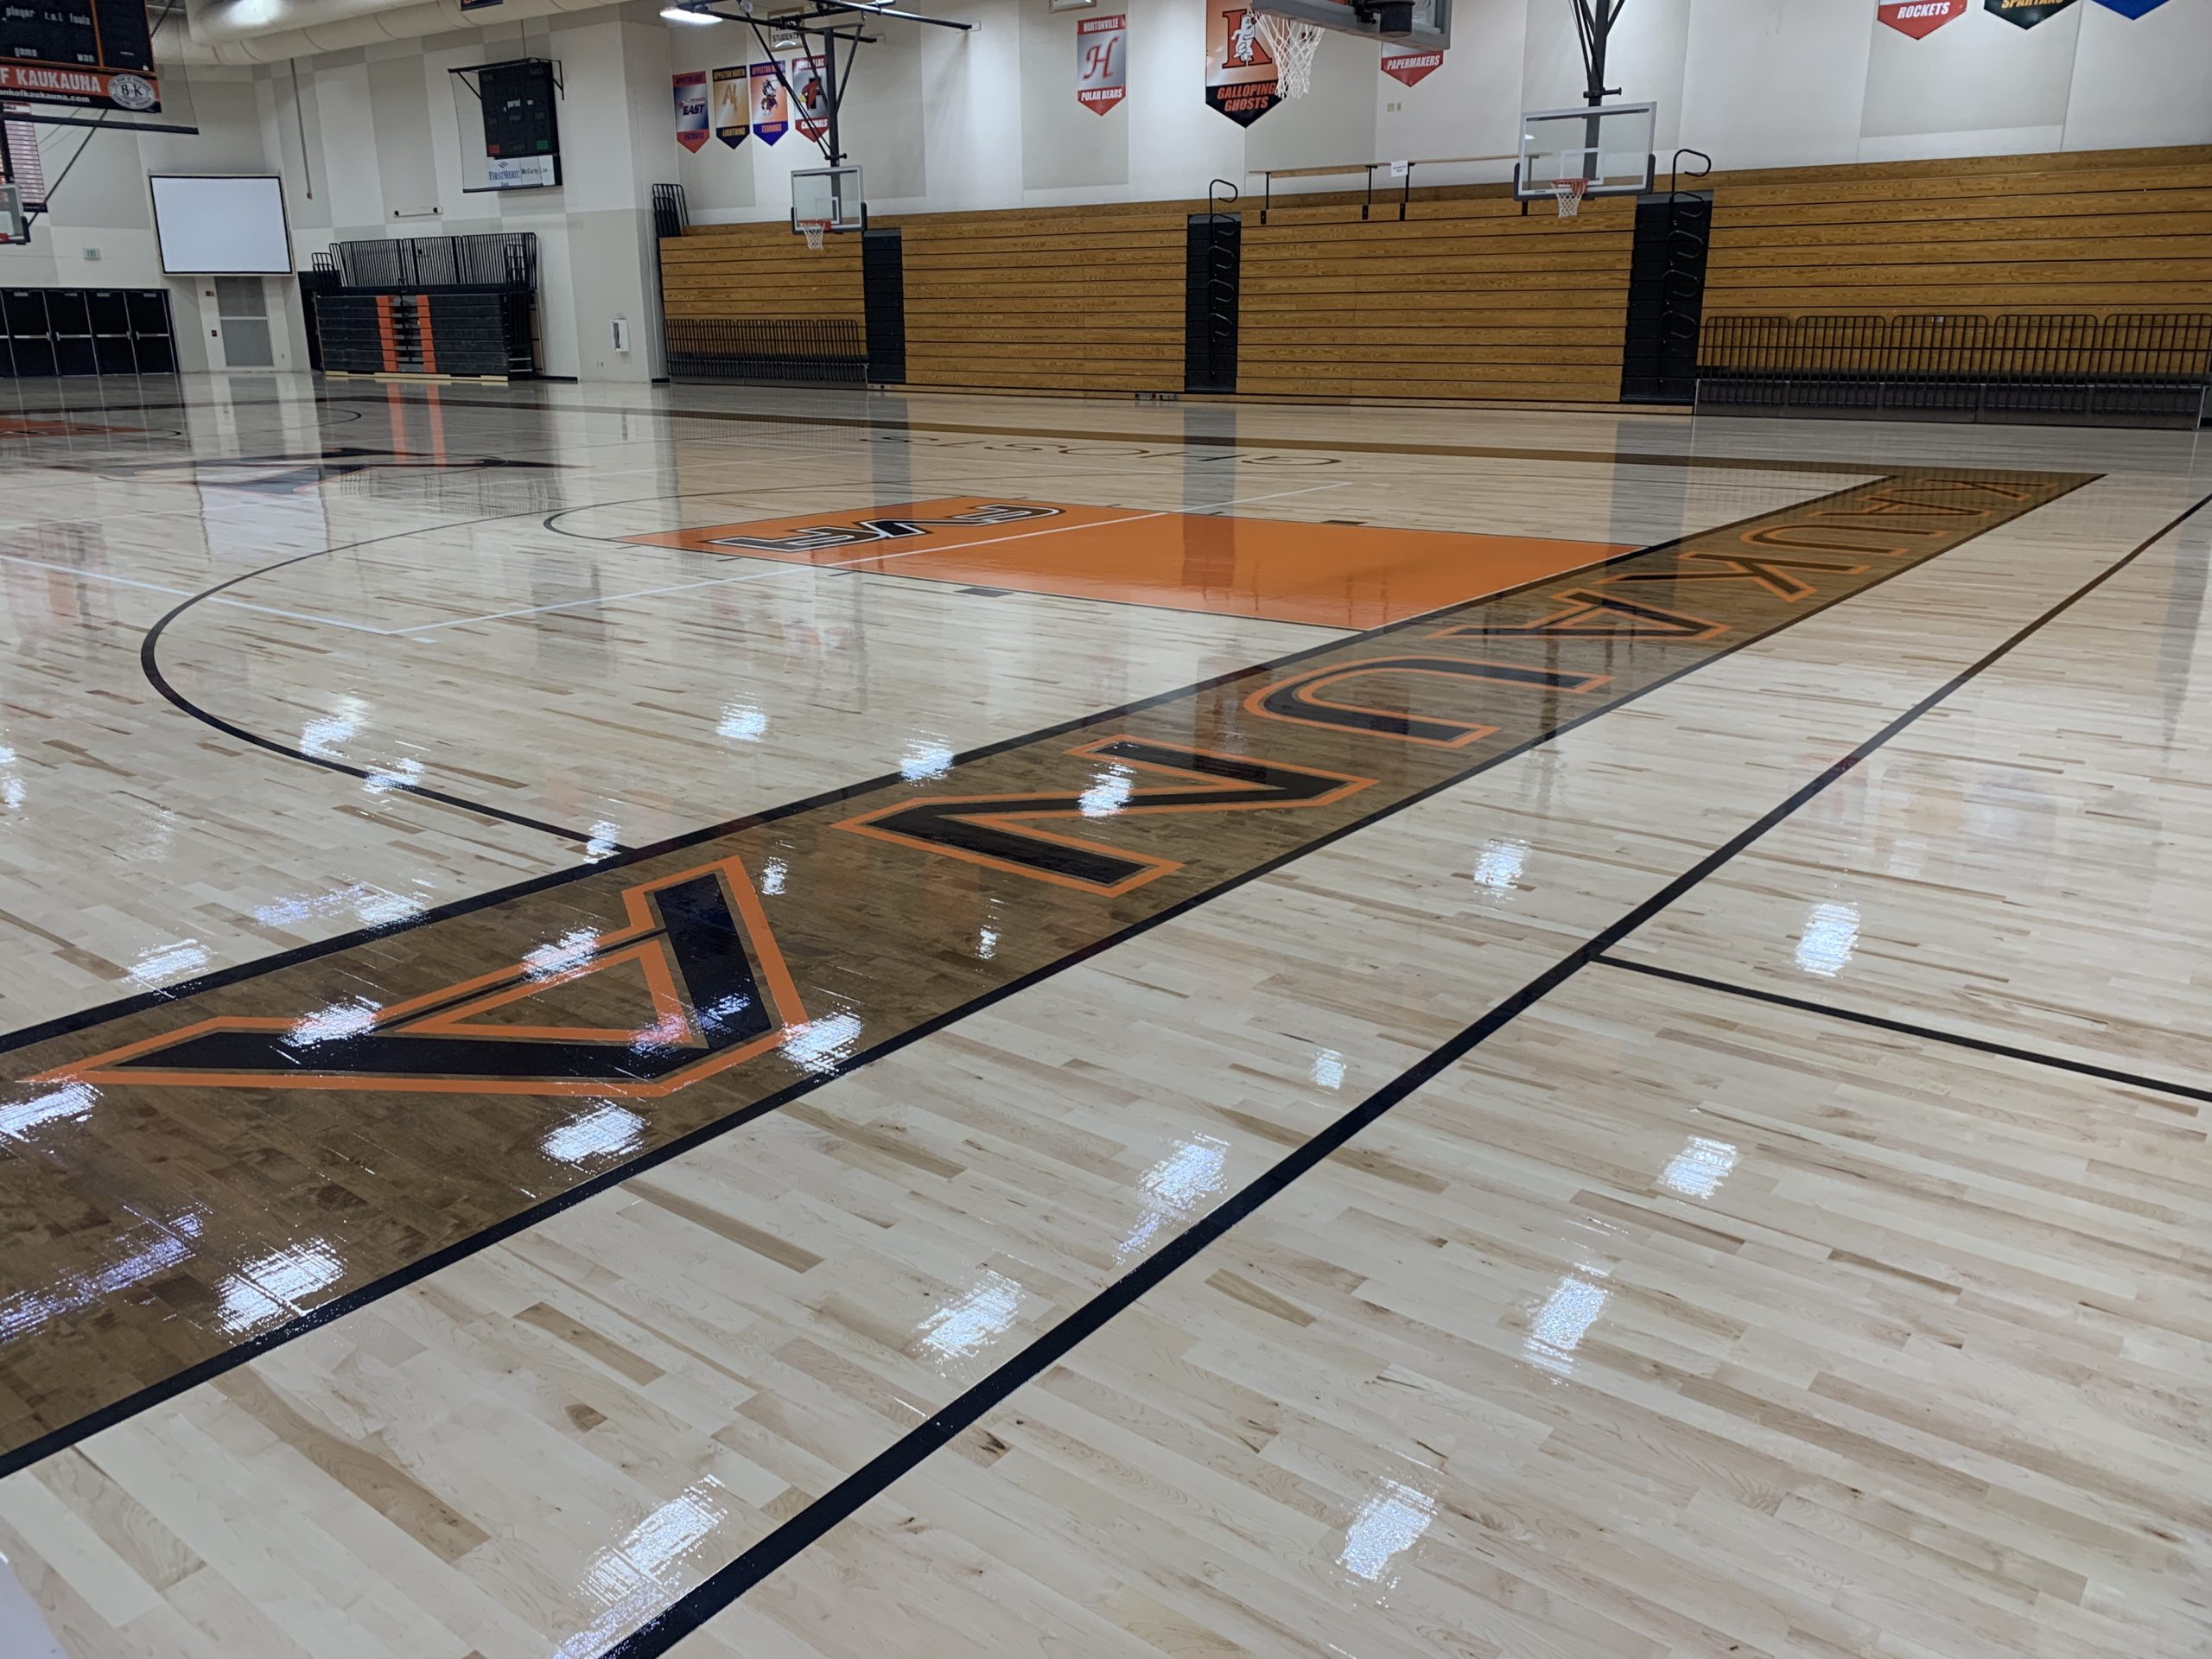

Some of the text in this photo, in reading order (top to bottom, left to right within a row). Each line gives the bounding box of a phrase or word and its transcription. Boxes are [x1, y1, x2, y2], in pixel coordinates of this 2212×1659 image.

[1897, 2, 1950, 19] ROCKETS
[1083, 18, 1119, 32] HORTONVILLE
[772, 33, 799, 42] STUDENTS
[1082, 35, 1119, 79] H
[1387, 55, 1440, 70] PAPERMAKERS
[16, 68, 101, 92] KAUKAUNA
[1081, 88, 1122, 101] POLAR BEARS
[1217, 82, 1276, 99] GALLOPING
[683, 104, 705, 116] EAST
[1224, 96, 1268, 111] GHOSTS
